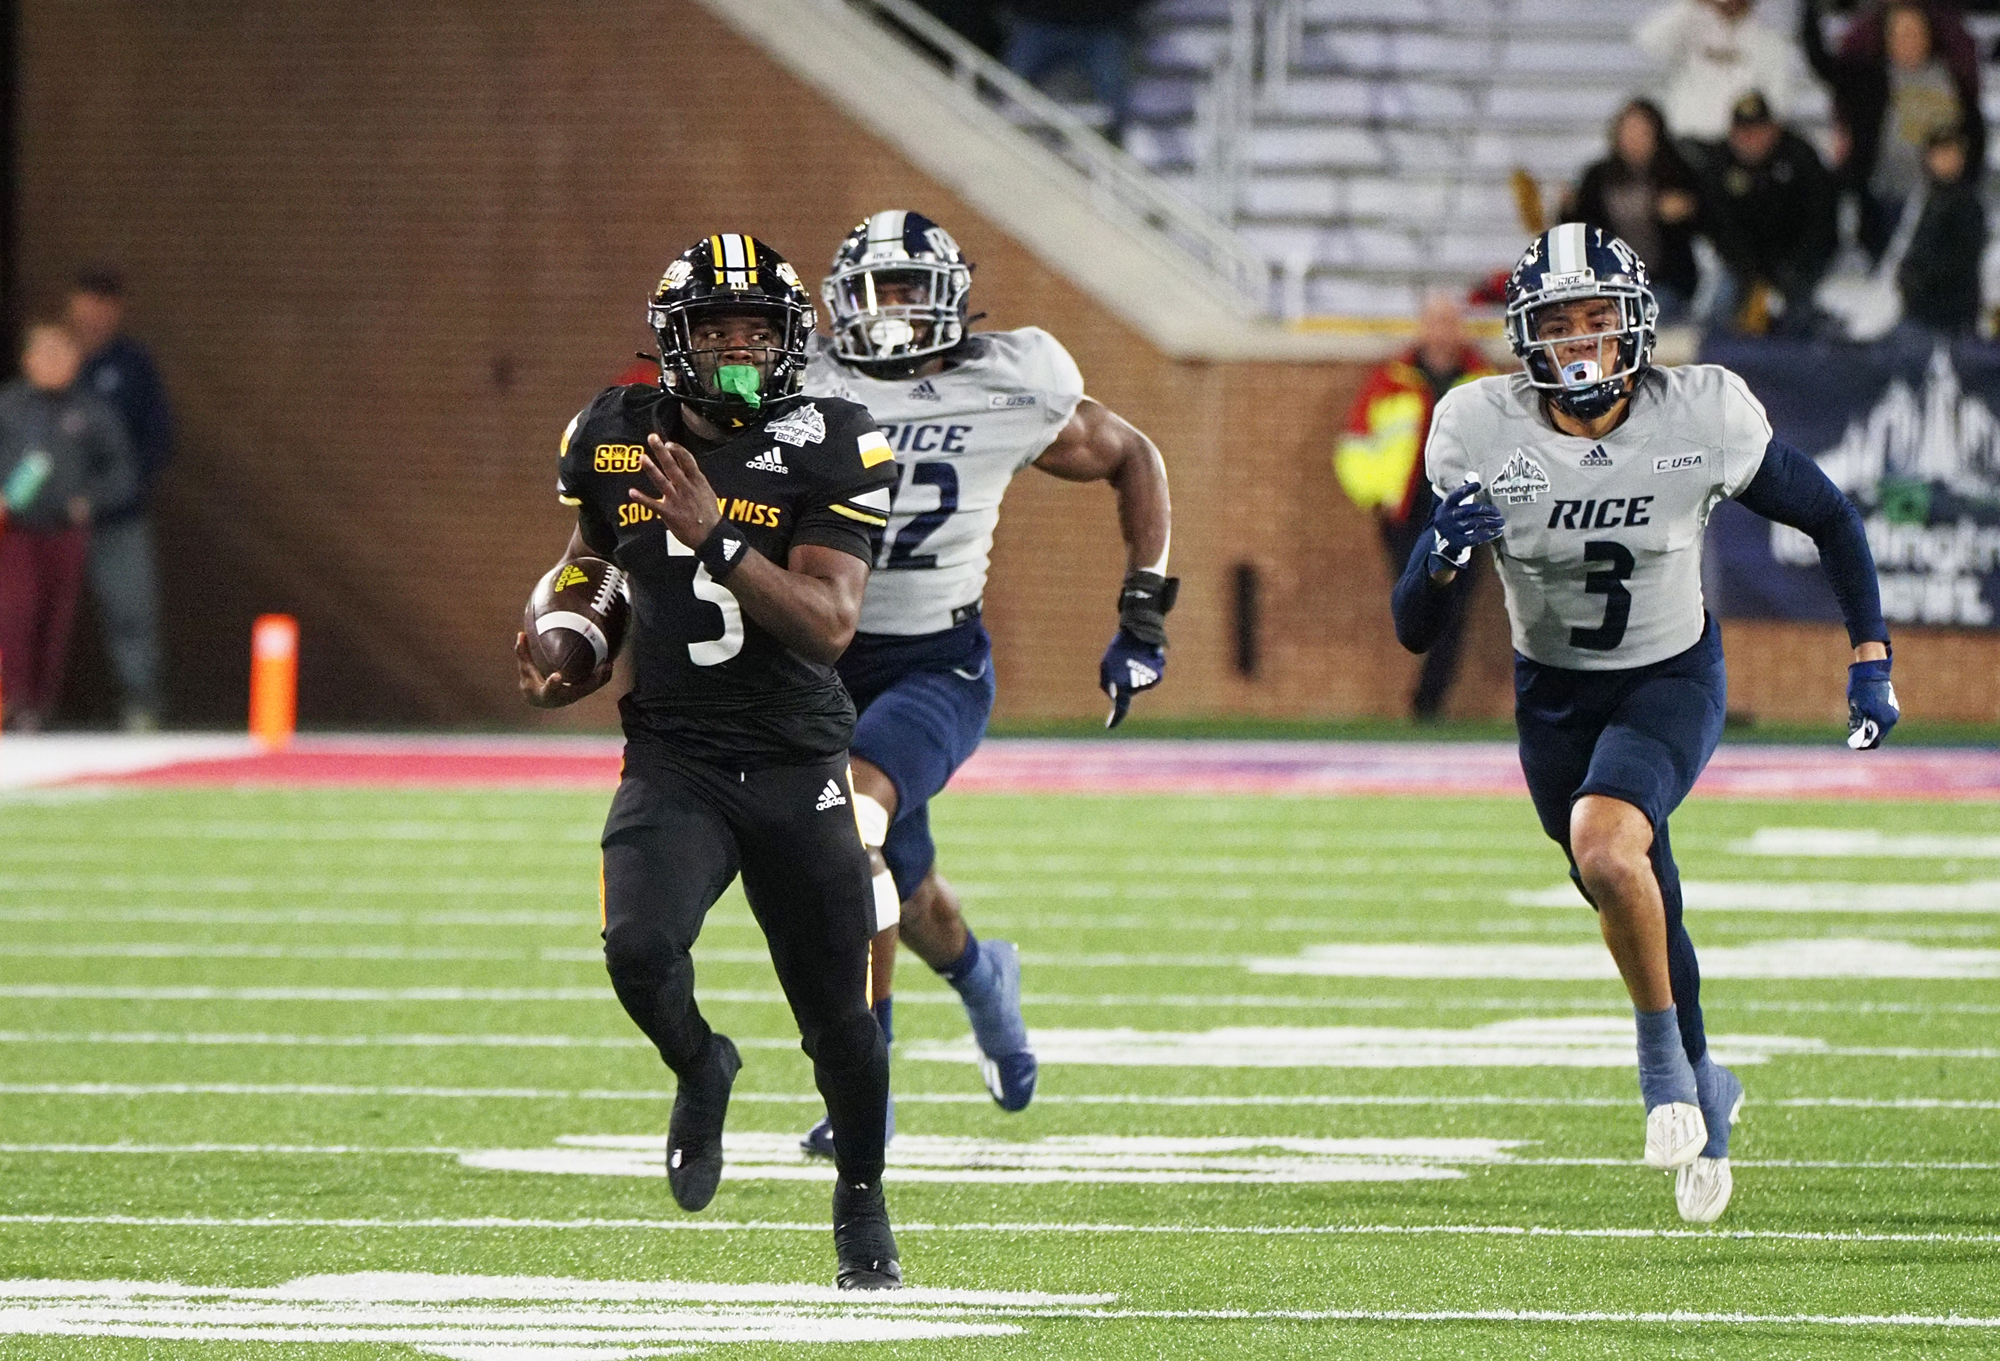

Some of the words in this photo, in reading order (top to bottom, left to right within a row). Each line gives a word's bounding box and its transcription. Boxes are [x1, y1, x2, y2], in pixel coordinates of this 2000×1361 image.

[777, 432, 802, 446] BOWL
[745, 460, 789, 475] adidas
[1580, 456, 1613, 466] adidas
[1492, 483, 1549, 495] lendingtree
[1510, 494, 1535, 504] BOWL
[728, 498, 782, 528] MISS
[1547, 496, 1655, 529] RICE
[554, 564, 574, 593] adidas
[1569, 540, 1636, 651] 3
[815, 795, 847, 811] adidas
